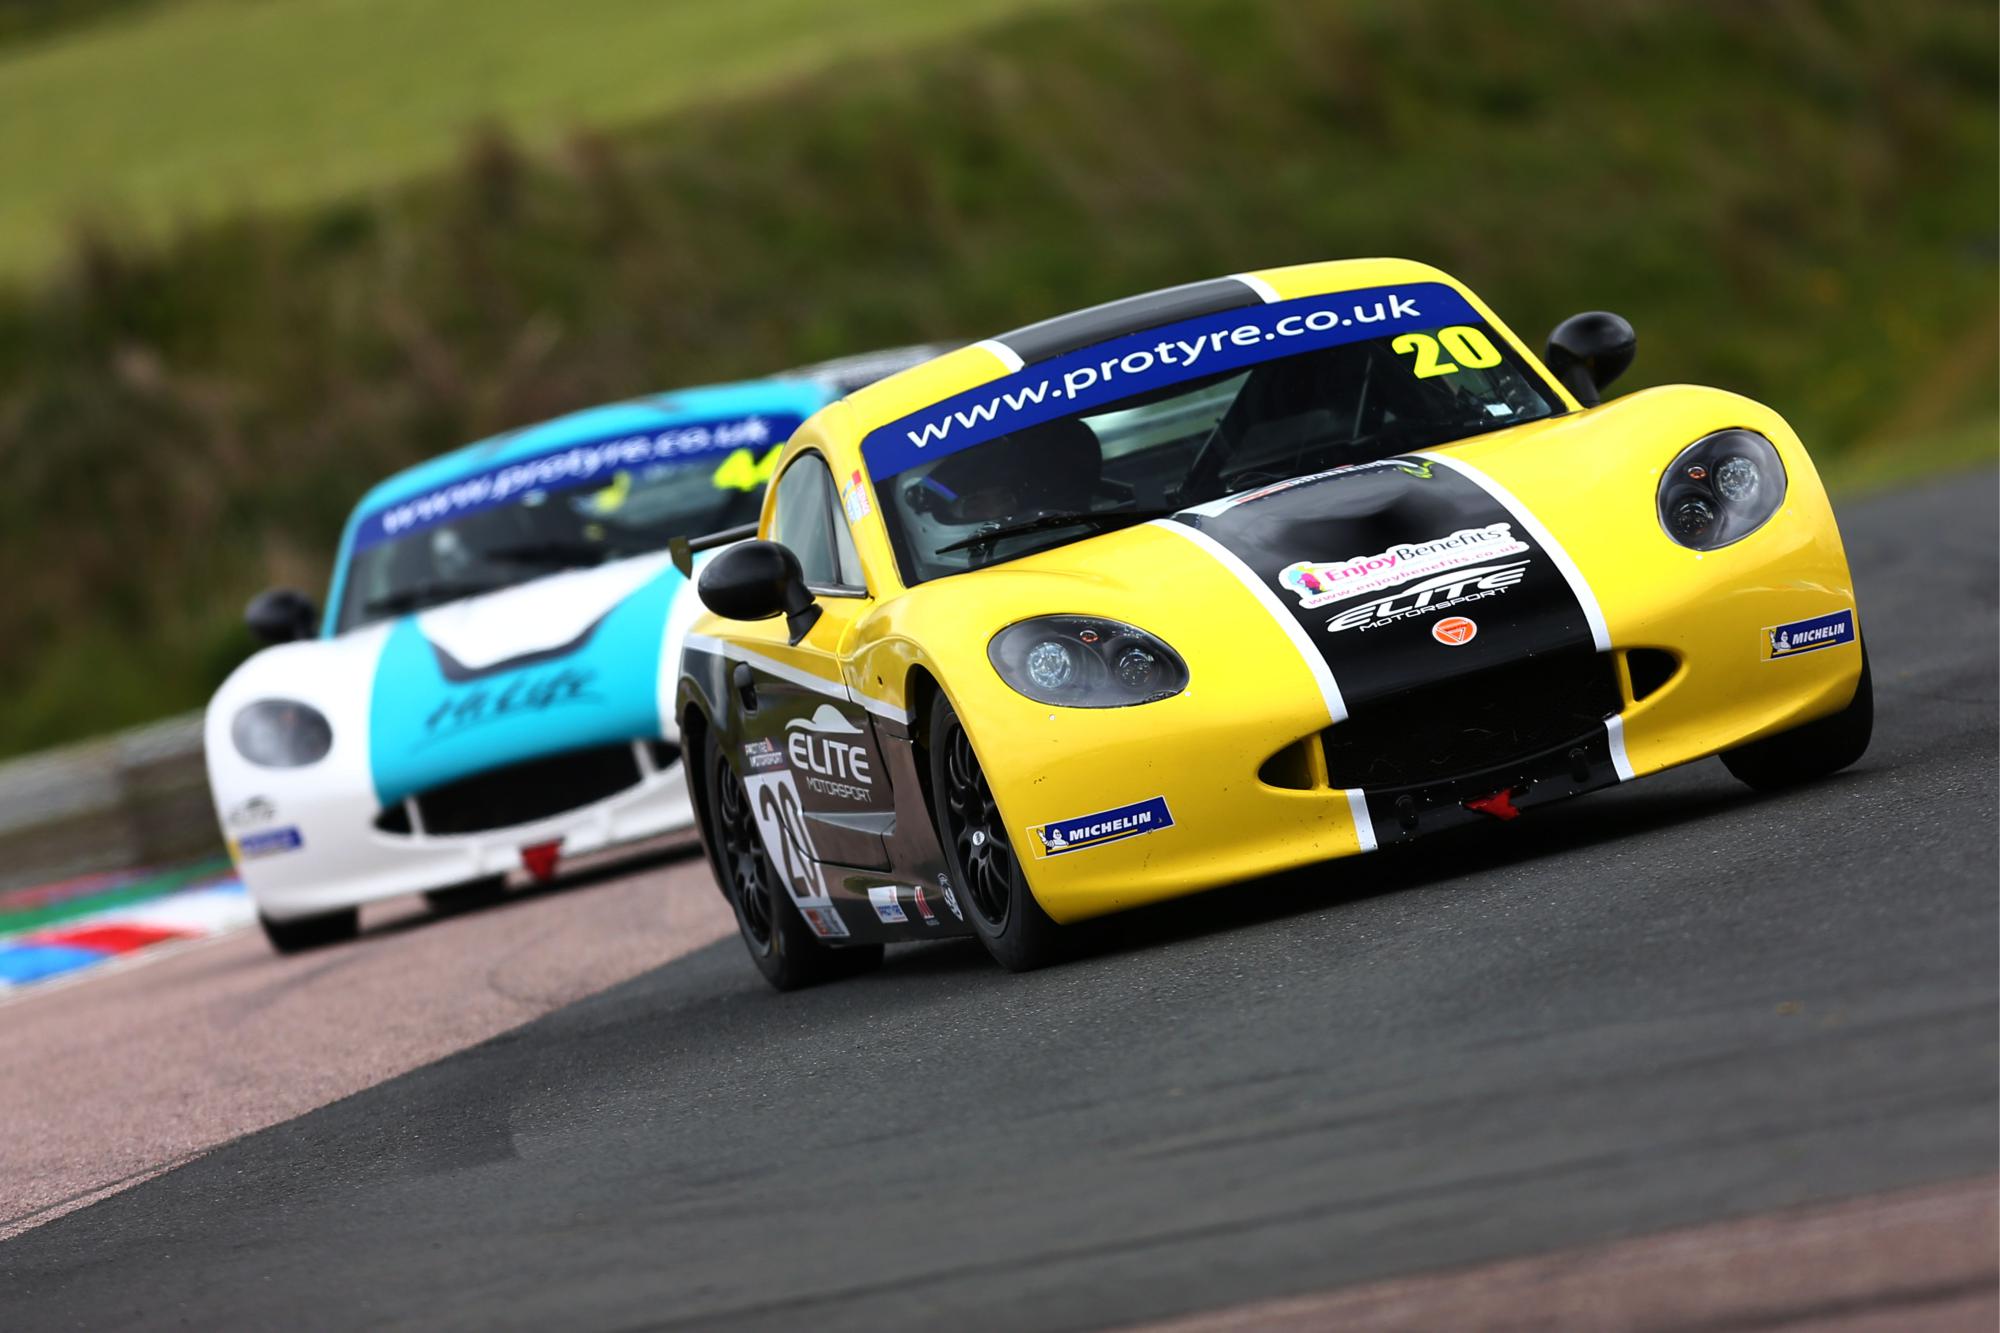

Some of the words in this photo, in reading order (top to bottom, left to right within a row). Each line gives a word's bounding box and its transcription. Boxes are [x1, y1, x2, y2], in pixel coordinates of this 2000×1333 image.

[907, 294, 1420, 448] www.protyre.co.uk
[1391, 325, 1502, 379] 20
[1308, 544, 1520, 605] www.enjoybenefits.co.uk
[1325, 529, 1502, 582] EnjoyBenefits
[1327, 564, 1526, 633] ELITE
[1359, 586, 1509, 632] MOTORSPORT
[1791, 622, 1845, 645] MICHELIN
[788, 732, 873, 784] ELITE
[806, 776, 872, 802] MOTORSPORT
[758, 780, 823, 898] 20
[1069, 811, 1152, 842] MICHELIN
